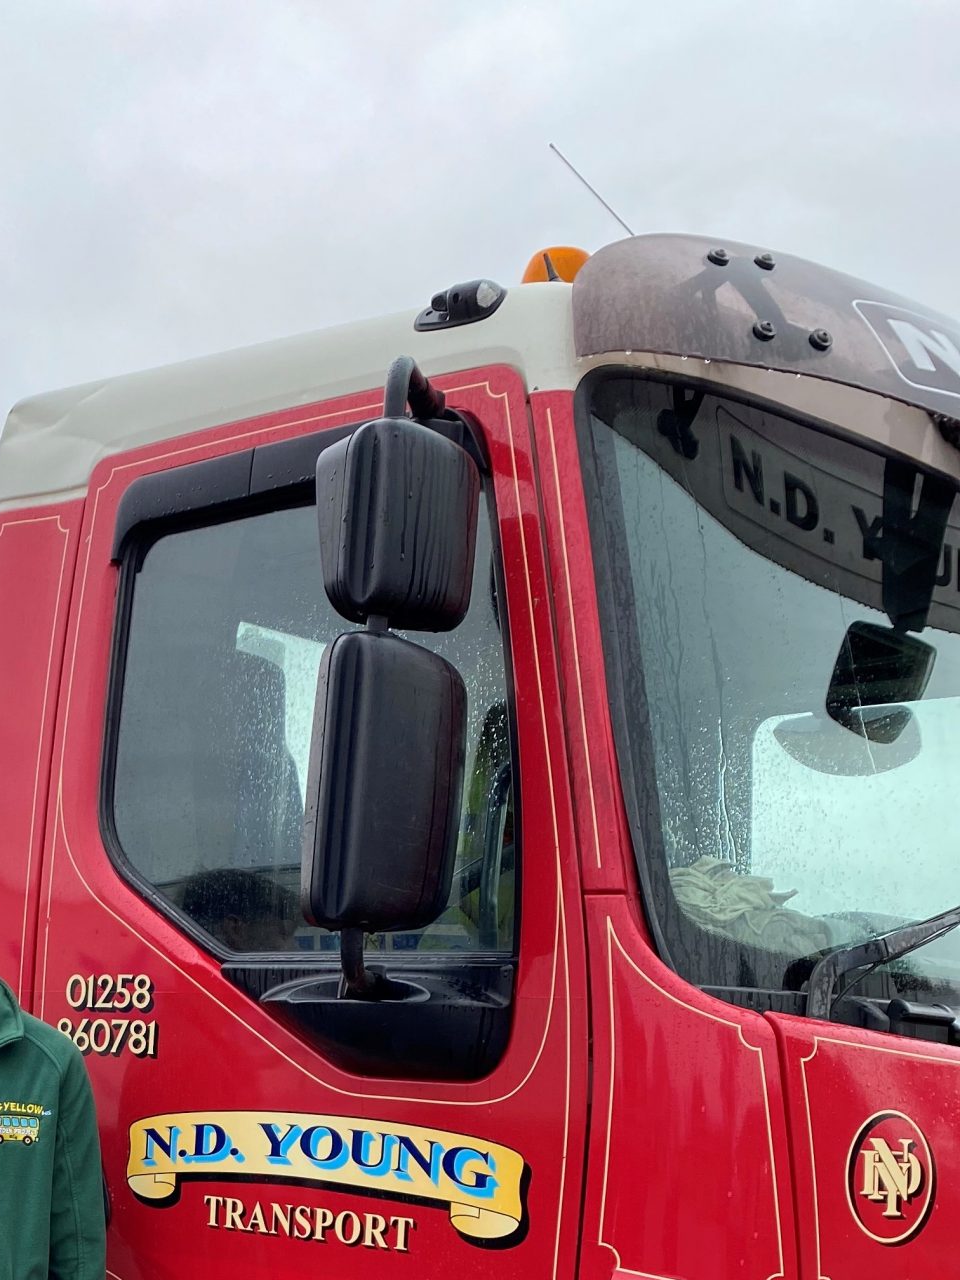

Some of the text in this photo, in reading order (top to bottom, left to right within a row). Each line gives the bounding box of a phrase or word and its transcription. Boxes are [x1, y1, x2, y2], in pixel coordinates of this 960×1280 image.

[730, 434, 835, 545] N.D.
[65, 973, 153, 1012] 01258
[3, 1102, 43, 1114] YELLOW
[141, 1122, 497, 1195] N.D. YOUNG
[204, 1195, 414, 1251] TRANSPORT
